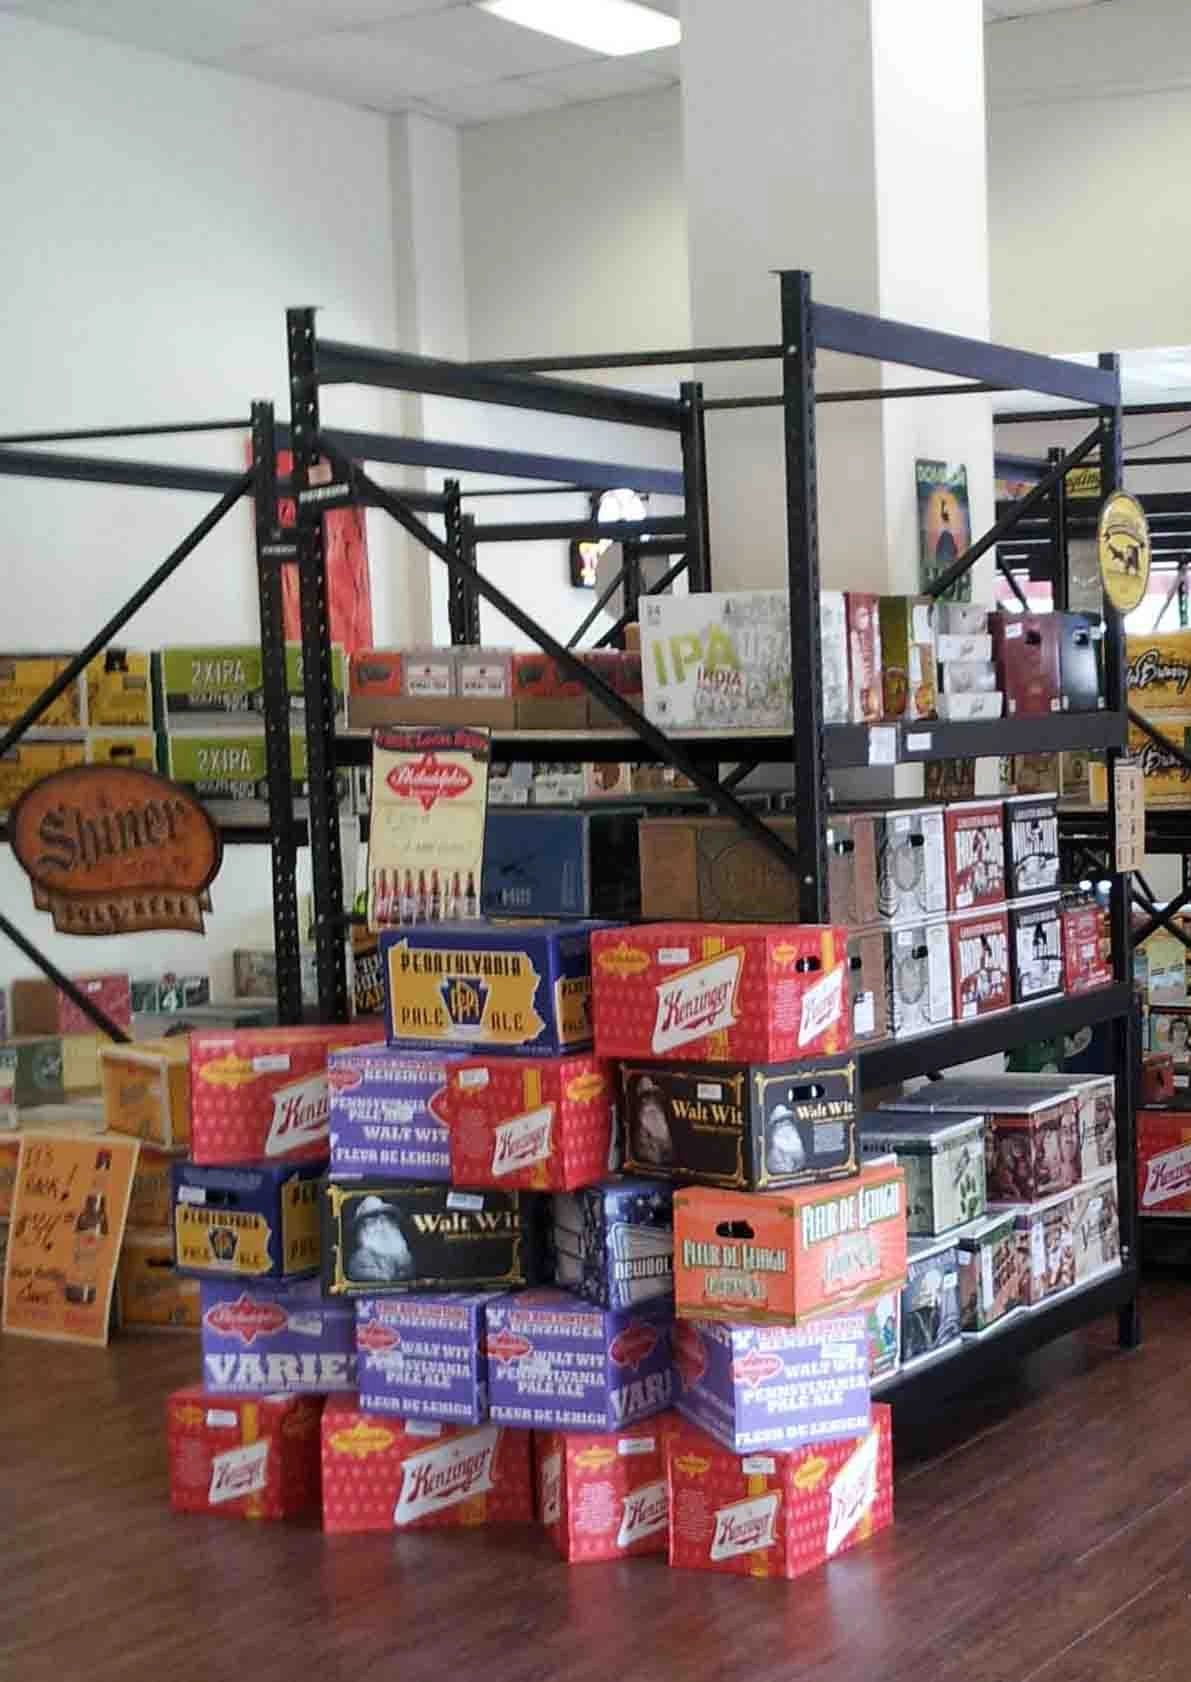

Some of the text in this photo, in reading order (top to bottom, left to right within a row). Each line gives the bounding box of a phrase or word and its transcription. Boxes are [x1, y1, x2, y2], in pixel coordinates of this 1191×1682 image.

[652, 622, 741, 688] IPA
[37, 798, 186, 874] Shiner
[672, 1099, 744, 1125] Walt Wit
[796, 1100, 828, 1121] Walt
[412, 1213, 521, 1233] Walt Wit
[205, 1353, 349, 1386] VARIE
[611, 1370, 673, 1419] VARI
